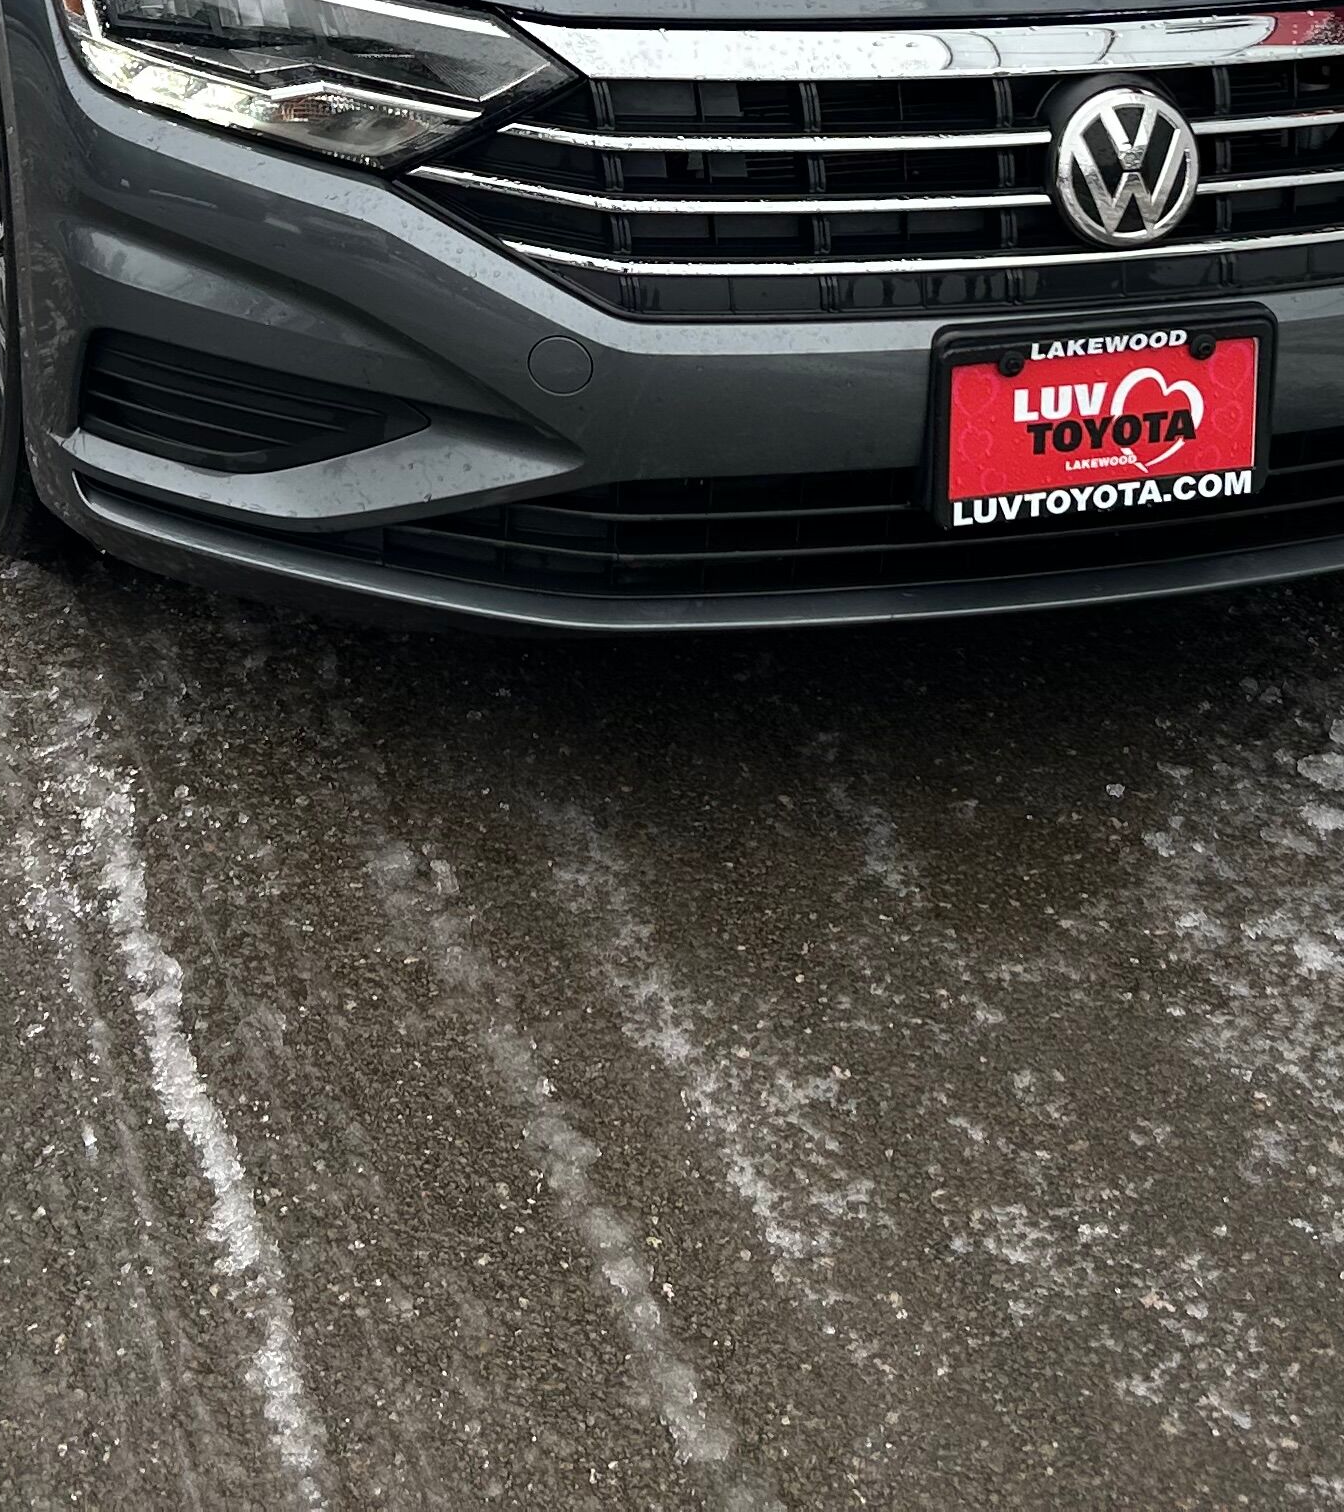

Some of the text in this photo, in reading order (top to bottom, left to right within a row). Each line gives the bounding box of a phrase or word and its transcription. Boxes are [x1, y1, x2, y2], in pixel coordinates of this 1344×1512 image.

[1031, 330, 1187, 360] LAKEWOOD
[1013, 382, 1109, 423] LUV
[1026, 409, 1197, 455] TOYOTA
[1065, 454, 1138, 471] LAKEWOOD
[953, 471, 1253, 526] LUVTOYOTA.COM
